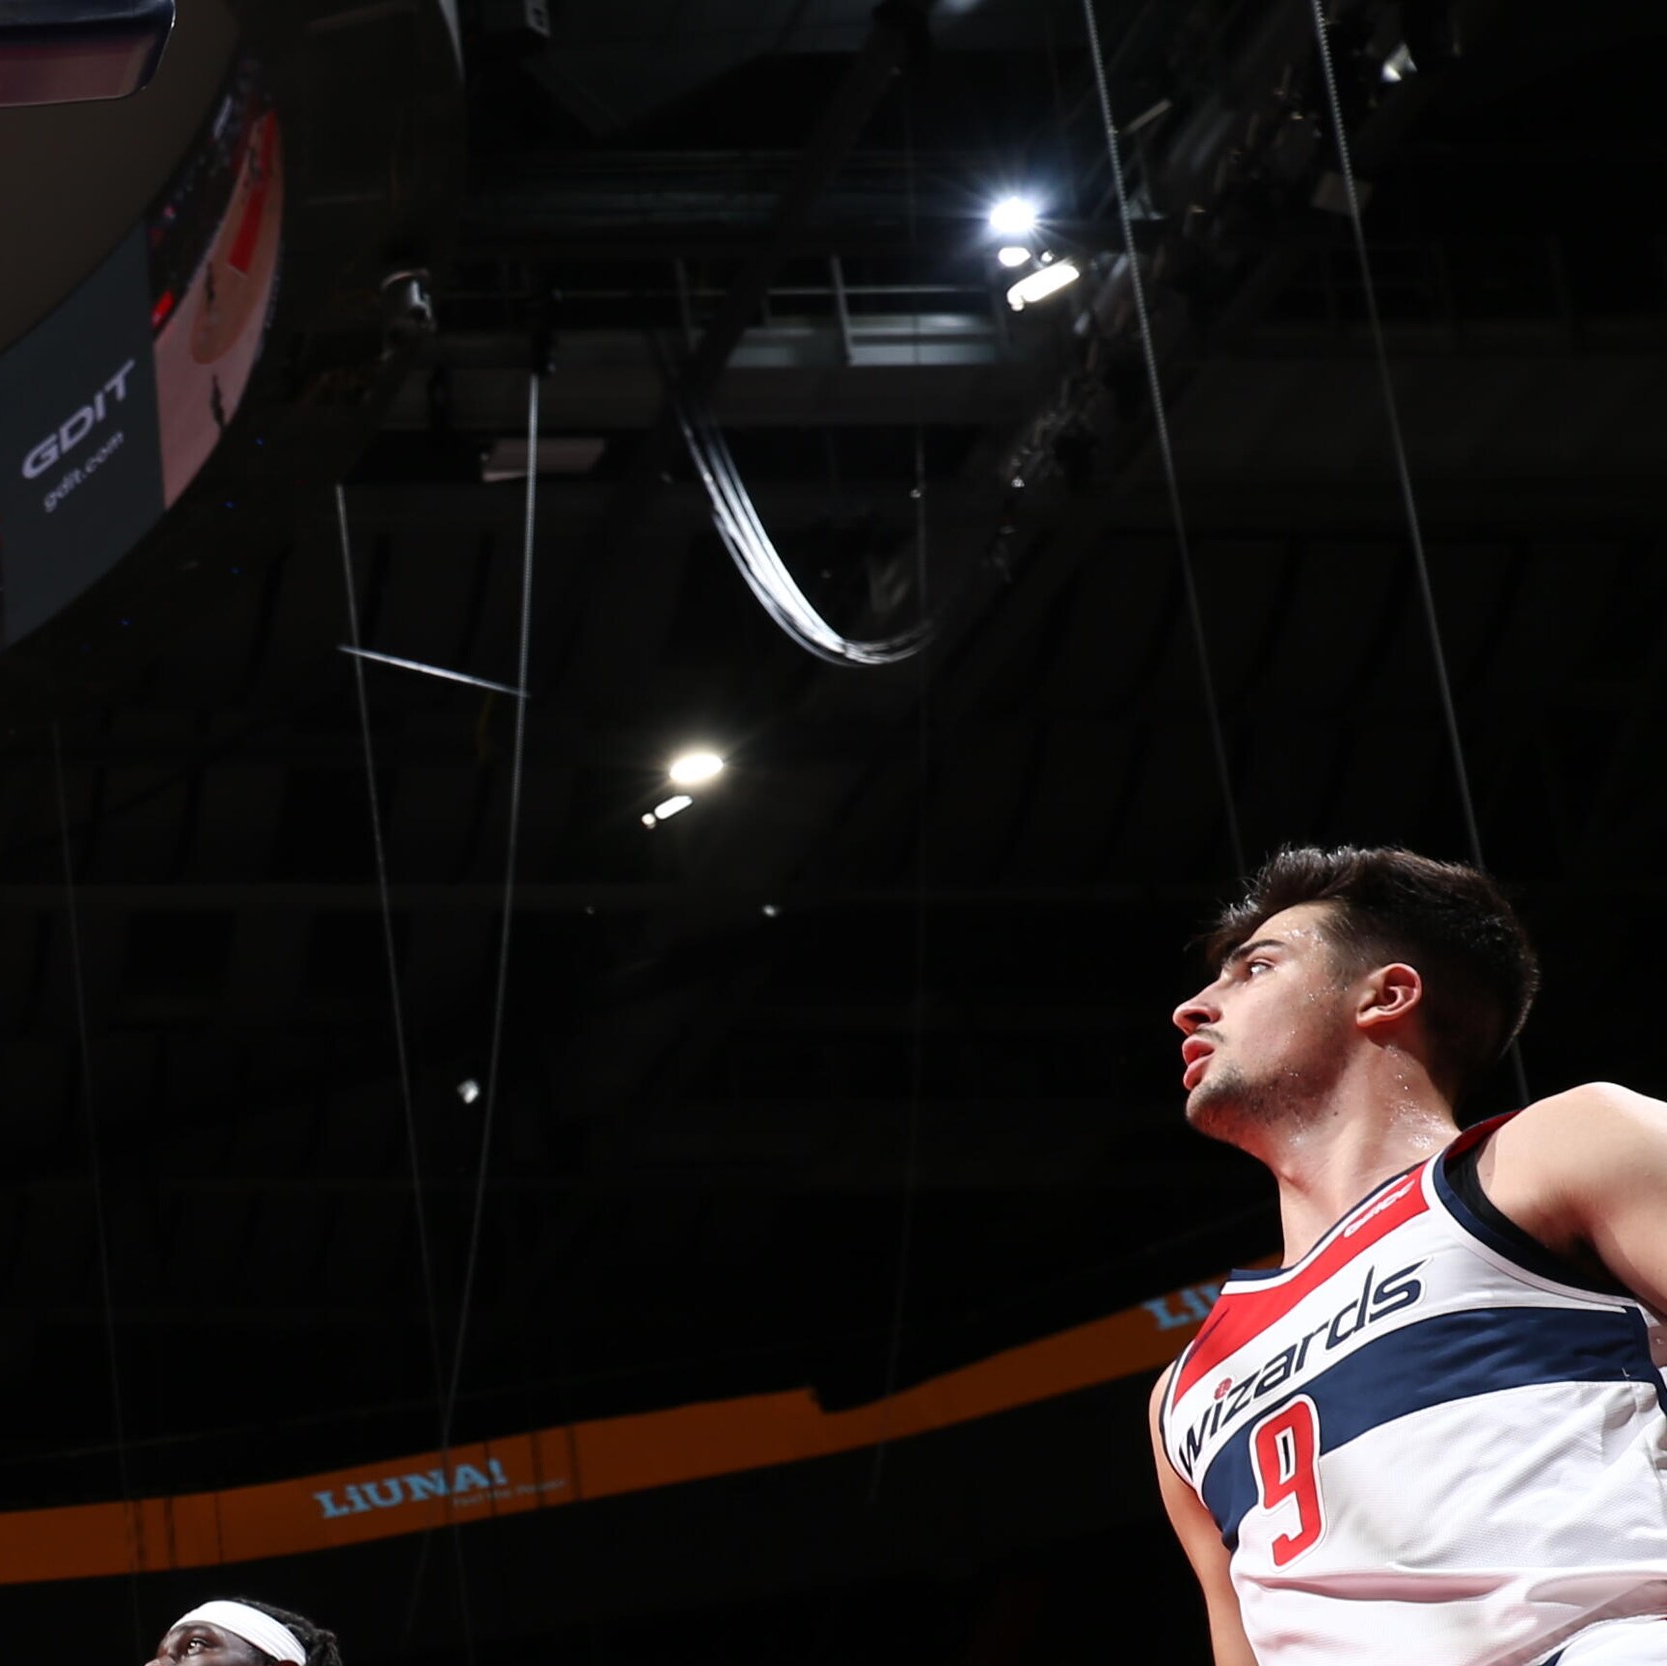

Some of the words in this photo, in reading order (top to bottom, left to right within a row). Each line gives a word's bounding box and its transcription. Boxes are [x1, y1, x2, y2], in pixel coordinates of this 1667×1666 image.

[21, 358, 136, 480] GDIT
[43, 430, 125, 513] gdit.com
[1176, 1258, 1427, 1477] wizards
[1254, 1400, 1323, 1567] 9
